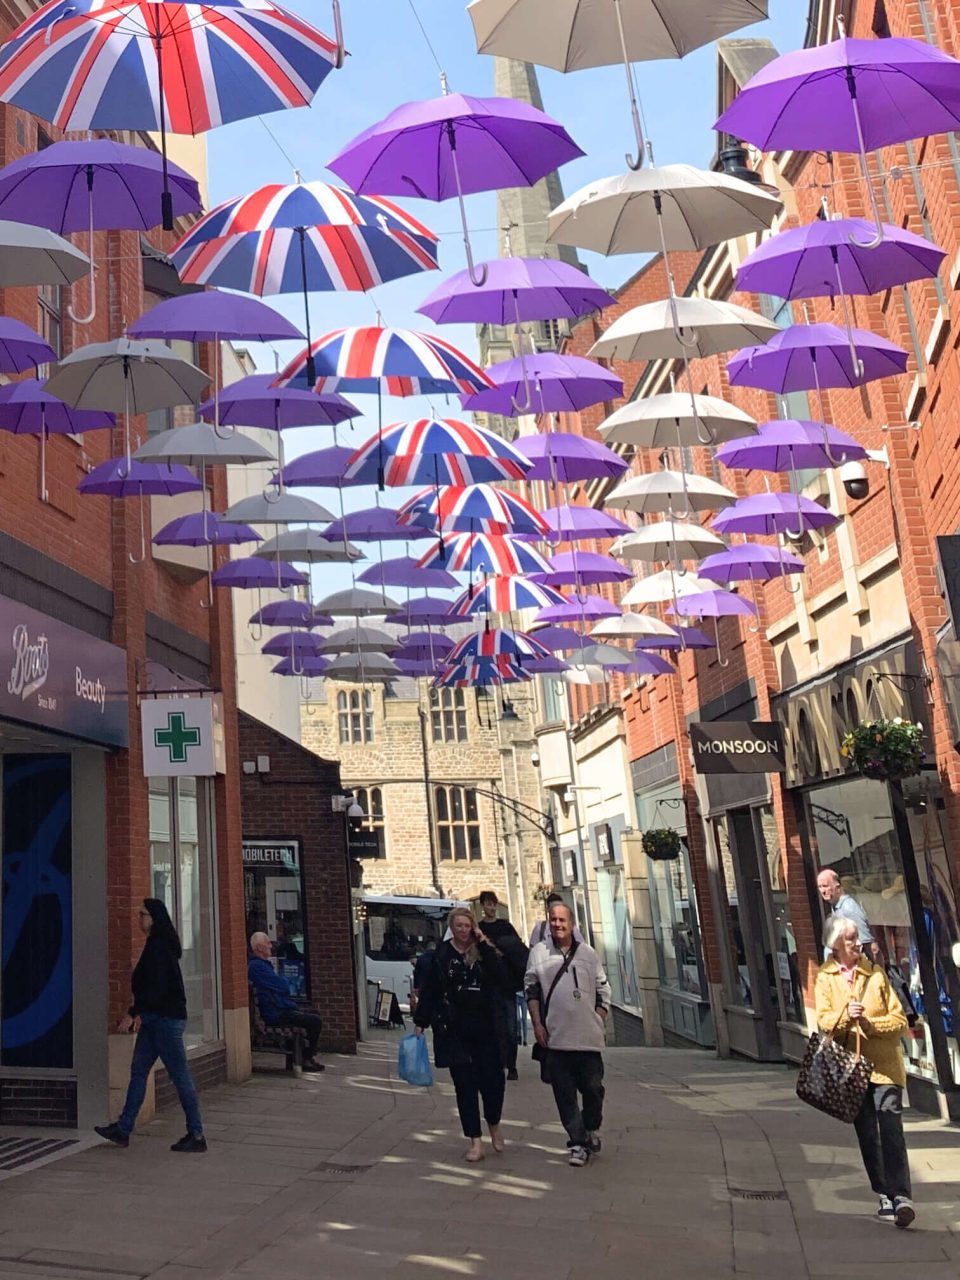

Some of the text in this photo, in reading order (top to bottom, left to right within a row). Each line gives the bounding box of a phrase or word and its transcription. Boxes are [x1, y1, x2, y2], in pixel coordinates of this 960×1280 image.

[7, 623, 50, 702] Boots
[75, 665, 107, 715] Beauty
[697, 739, 779, 754] MONSOON
